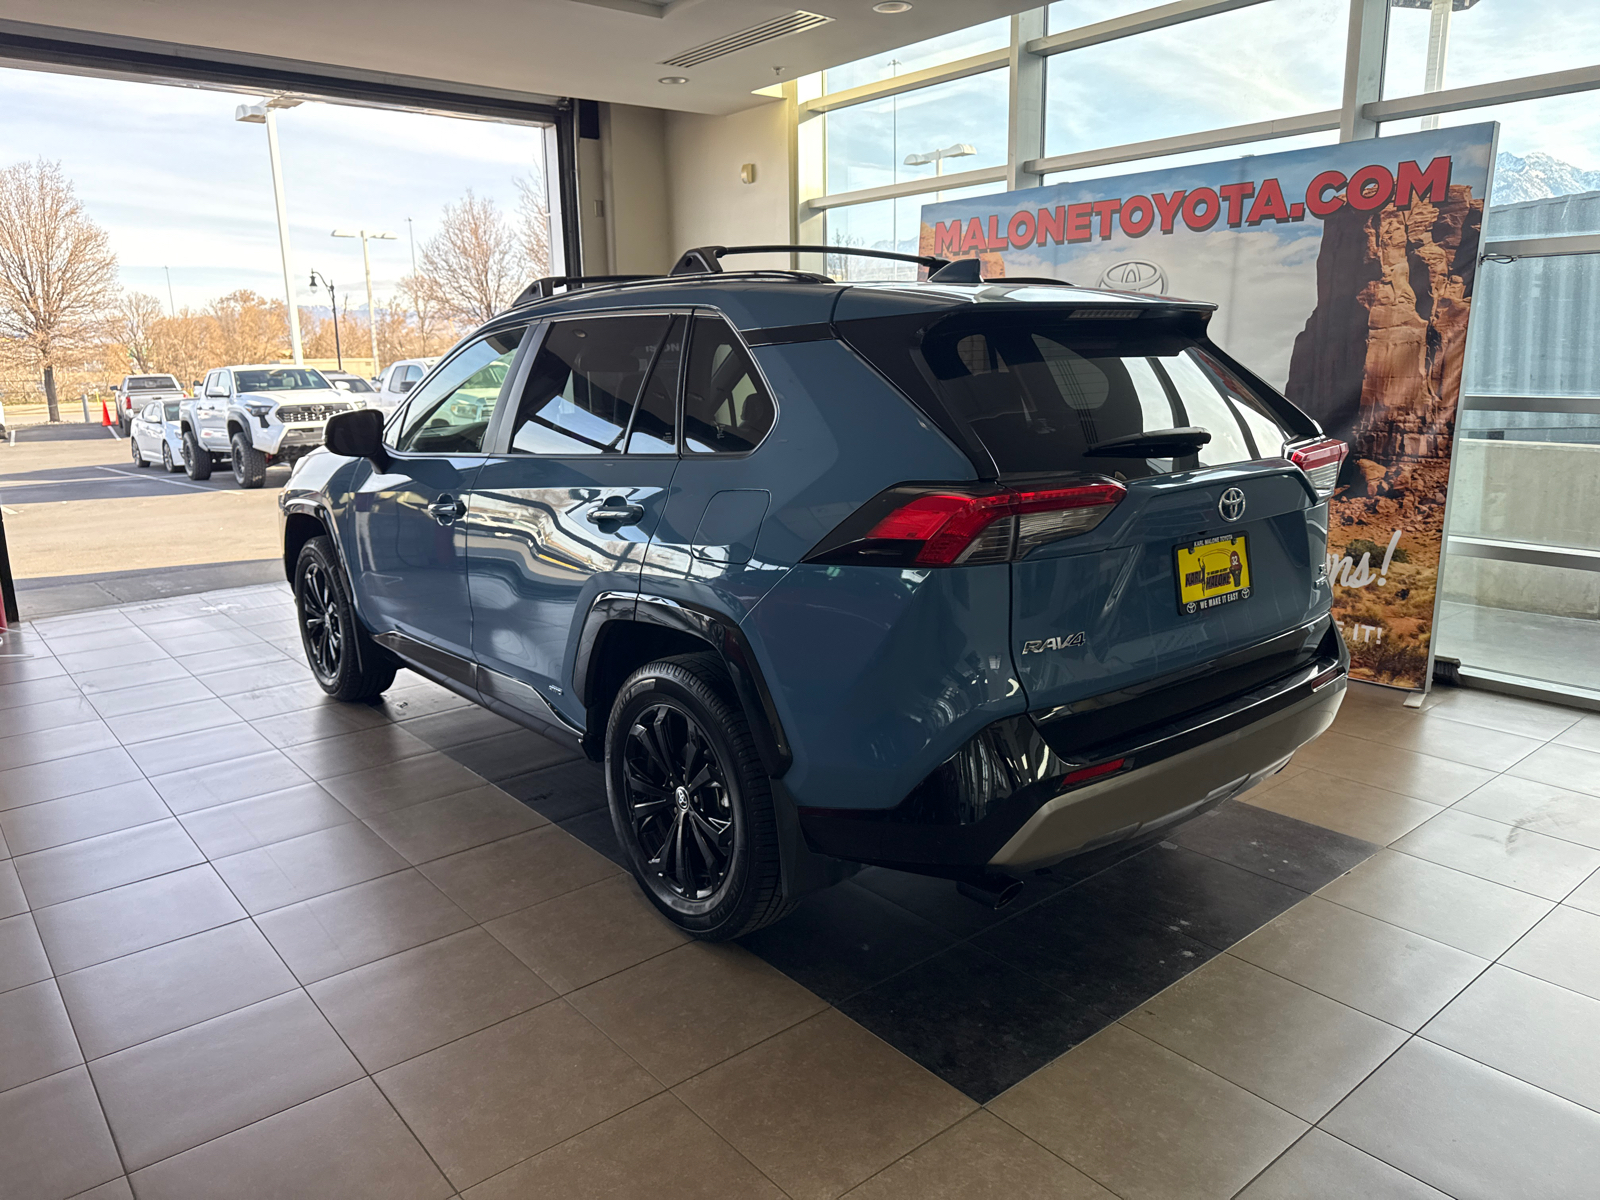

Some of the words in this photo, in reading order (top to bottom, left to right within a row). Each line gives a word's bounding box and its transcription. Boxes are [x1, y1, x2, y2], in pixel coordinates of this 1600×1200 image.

[935, 156, 1452, 254] MALONETOYOTA.COM
[1205, 537, 1220, 545] MALONE
[1220, 534, 1233, 542] TOYOTA
[1200, 600, 1207, 609] WE
[1209, 597, 1221, 607] MAKE
[1222, 595, 1226, 603] IT
[1227, 592, 1239, 602] EASY
[1022, 631, 1086, 655] RAV4
[1352, 623, 1382, 645] IT!
